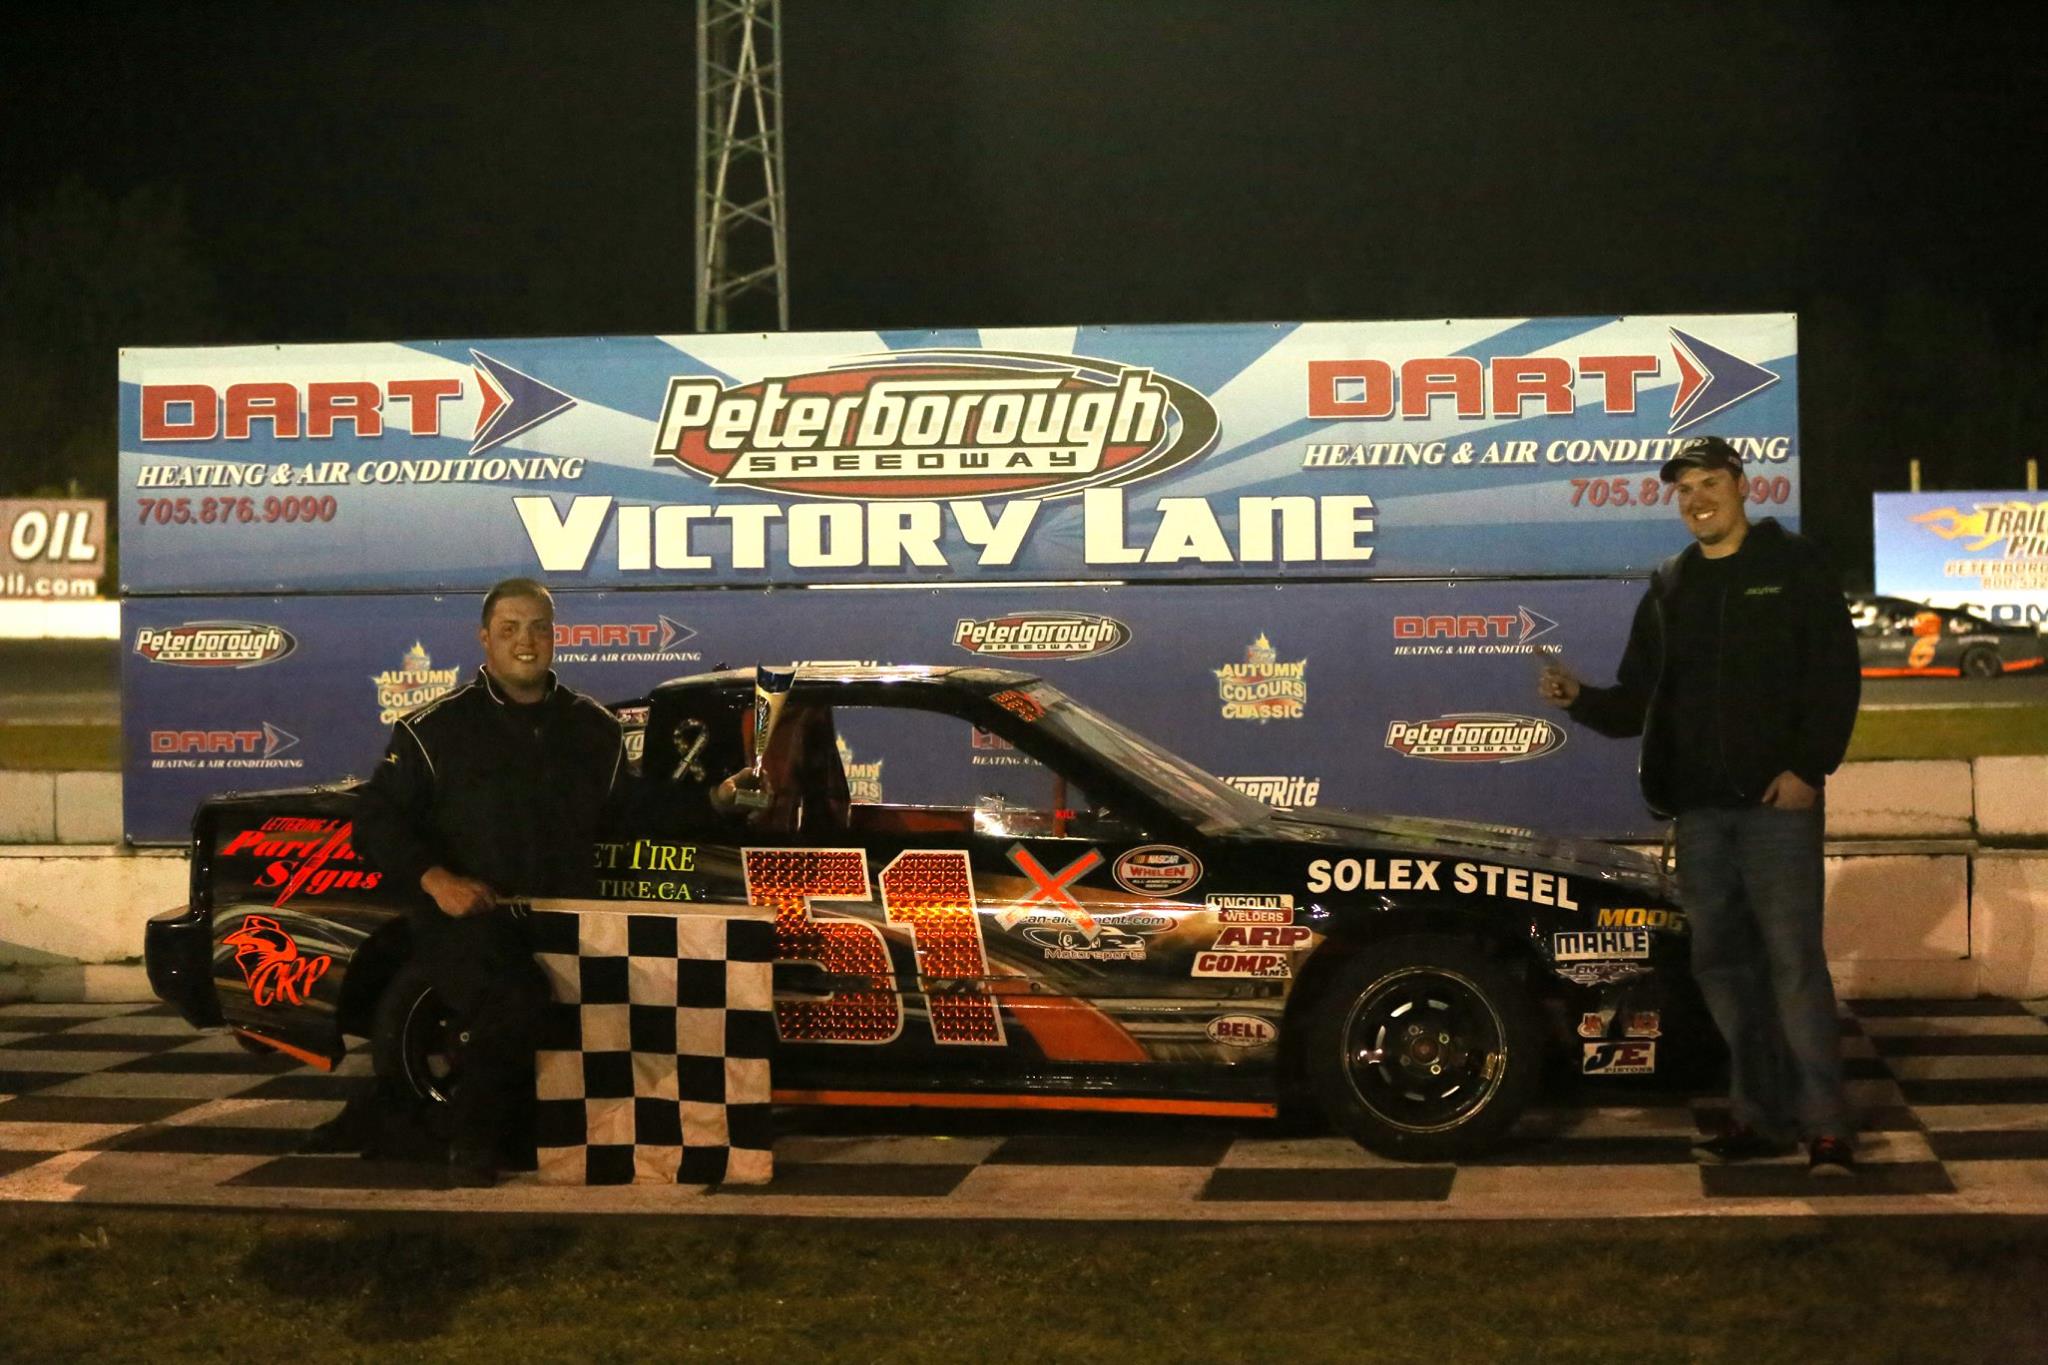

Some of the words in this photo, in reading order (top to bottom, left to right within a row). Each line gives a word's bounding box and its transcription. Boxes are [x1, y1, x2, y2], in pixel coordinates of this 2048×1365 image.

[1308, 355, 1658, 418] DART
[141, 379, 461, 441] DART
[655, 368, 1168, 452] Peterborough
[748, 450, 1077, 472] SPEEDWAY
[1304, 441, 1446, 467] HEATING
[1451, 440, 1474, 464] &
[1480, 440, 1538, 464] AIR
[1546, 436, 1790, 463] CONDITIING
[136, 462, 267, 488] HEATING
[269, 462, 293, 485] &
[295, 460, 351, 485] AIR
[356, 457, 585, 483] CONDITIONING
[136, 496, 337, 524] 705.876.9090
[9, 510, 97, 560] OIL
[513, 496, 1043, 571] VICTORY
[1084, 488, 1375, 563] LANE
[955, 619, 1115, 644] Peterborough
[1393, 615, 1517, 639] DART
[136, 628, 281, 651] Peterborough
[1394, 645, 1444, 655] HEATING
[1456, 645, 1476, 654] AIR
[1478, 644, 1562, 654] CONDITIOING
[555, 653, 588, 663] ATING
[600, 653, 619, 662] AIR
[620, 652, 701, 662] CONDITIONING
[381, 670, 457, 685] AUTUMN
[1222, 662, 1304, 678] AUTUMN
[381, 686, 448, 707] COLOUR
[1222, 680, 1304, 701] COLOURS
[1221, 703, 1305, 719] CLASSIC
[151, 730, 263, 753] DART
[1388, 720, 1550, 746] Peterborough
[151, 759, 196, 769] HEATING
[208, 759, 225, 768] AIR
[227, 759, 303, 768] CONDITIONING
[629, 838, 697, 871] TIRE
[1130, 865, 1186, 877] WHELEN
[1307, 859, 1441, 894] SOLEX
[1453, 862, 1579, 912] STEEL
[1225, 910, 1285, 922] WELDERS
[741, 847, 1008, 1046] 51
[1215, 926, 1312, 946] ARP
[1556, 932, 1647, 954] MAHLE
[1197, 954, 1277, 973] COMP
[1217, 1021, 1267, 1039] BELL
[1584, 1043, 1651, 1072] JE
